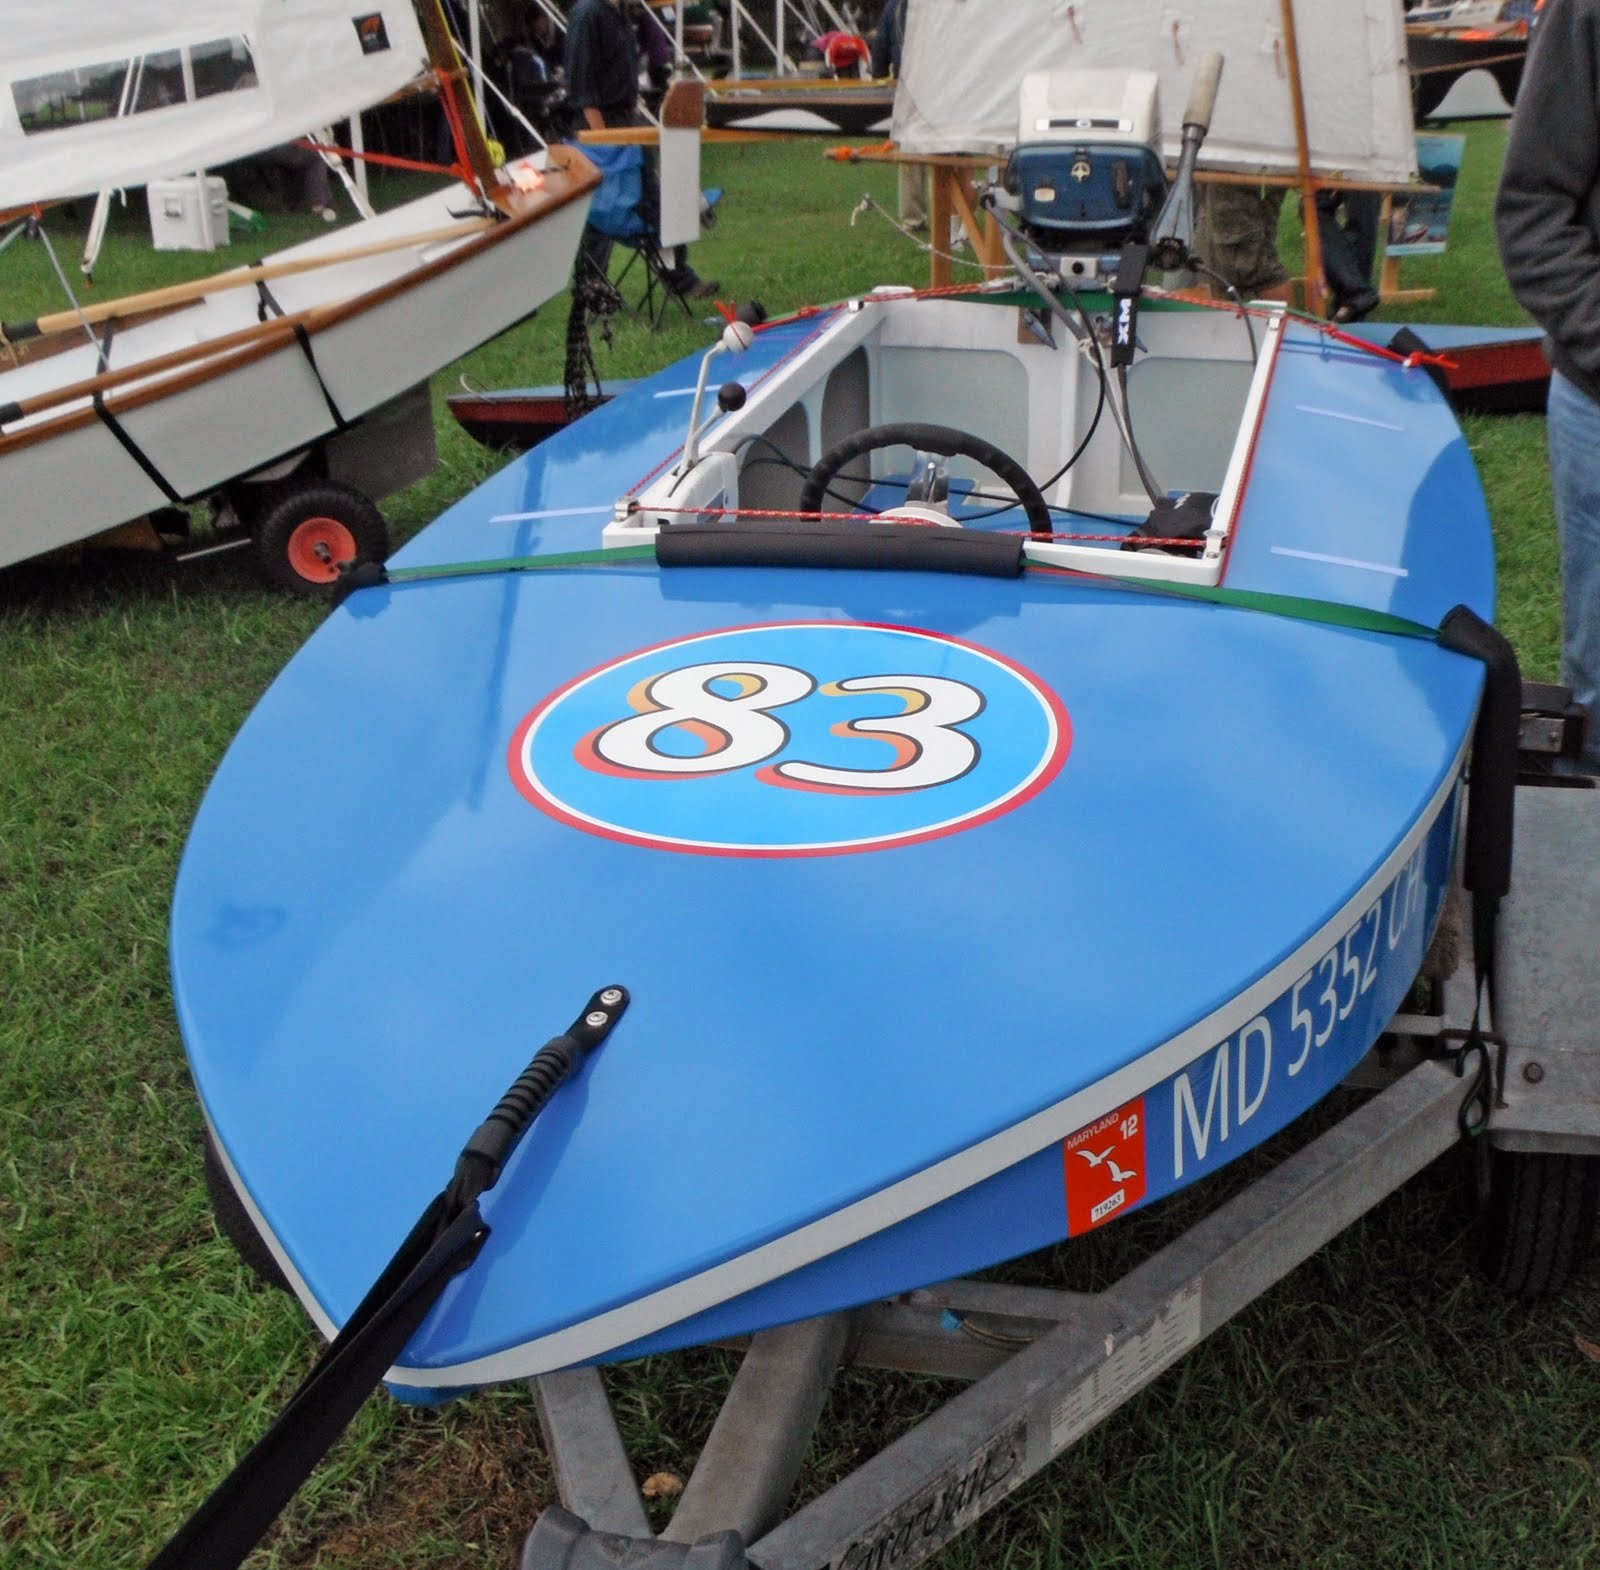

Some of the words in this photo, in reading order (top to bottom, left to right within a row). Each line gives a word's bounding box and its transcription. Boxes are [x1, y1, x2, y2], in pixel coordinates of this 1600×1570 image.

[571, 660, 987, 797] 83
[1173, 1014, 1272, 1180] MD
[1288, 898, 1383, 1077] 5352
[1067, 1113, 1119, 1149] MARYLAND
[1120, 1114, 1138, 1140] 12
[1094, 1194, 1121, 1218] 719263
